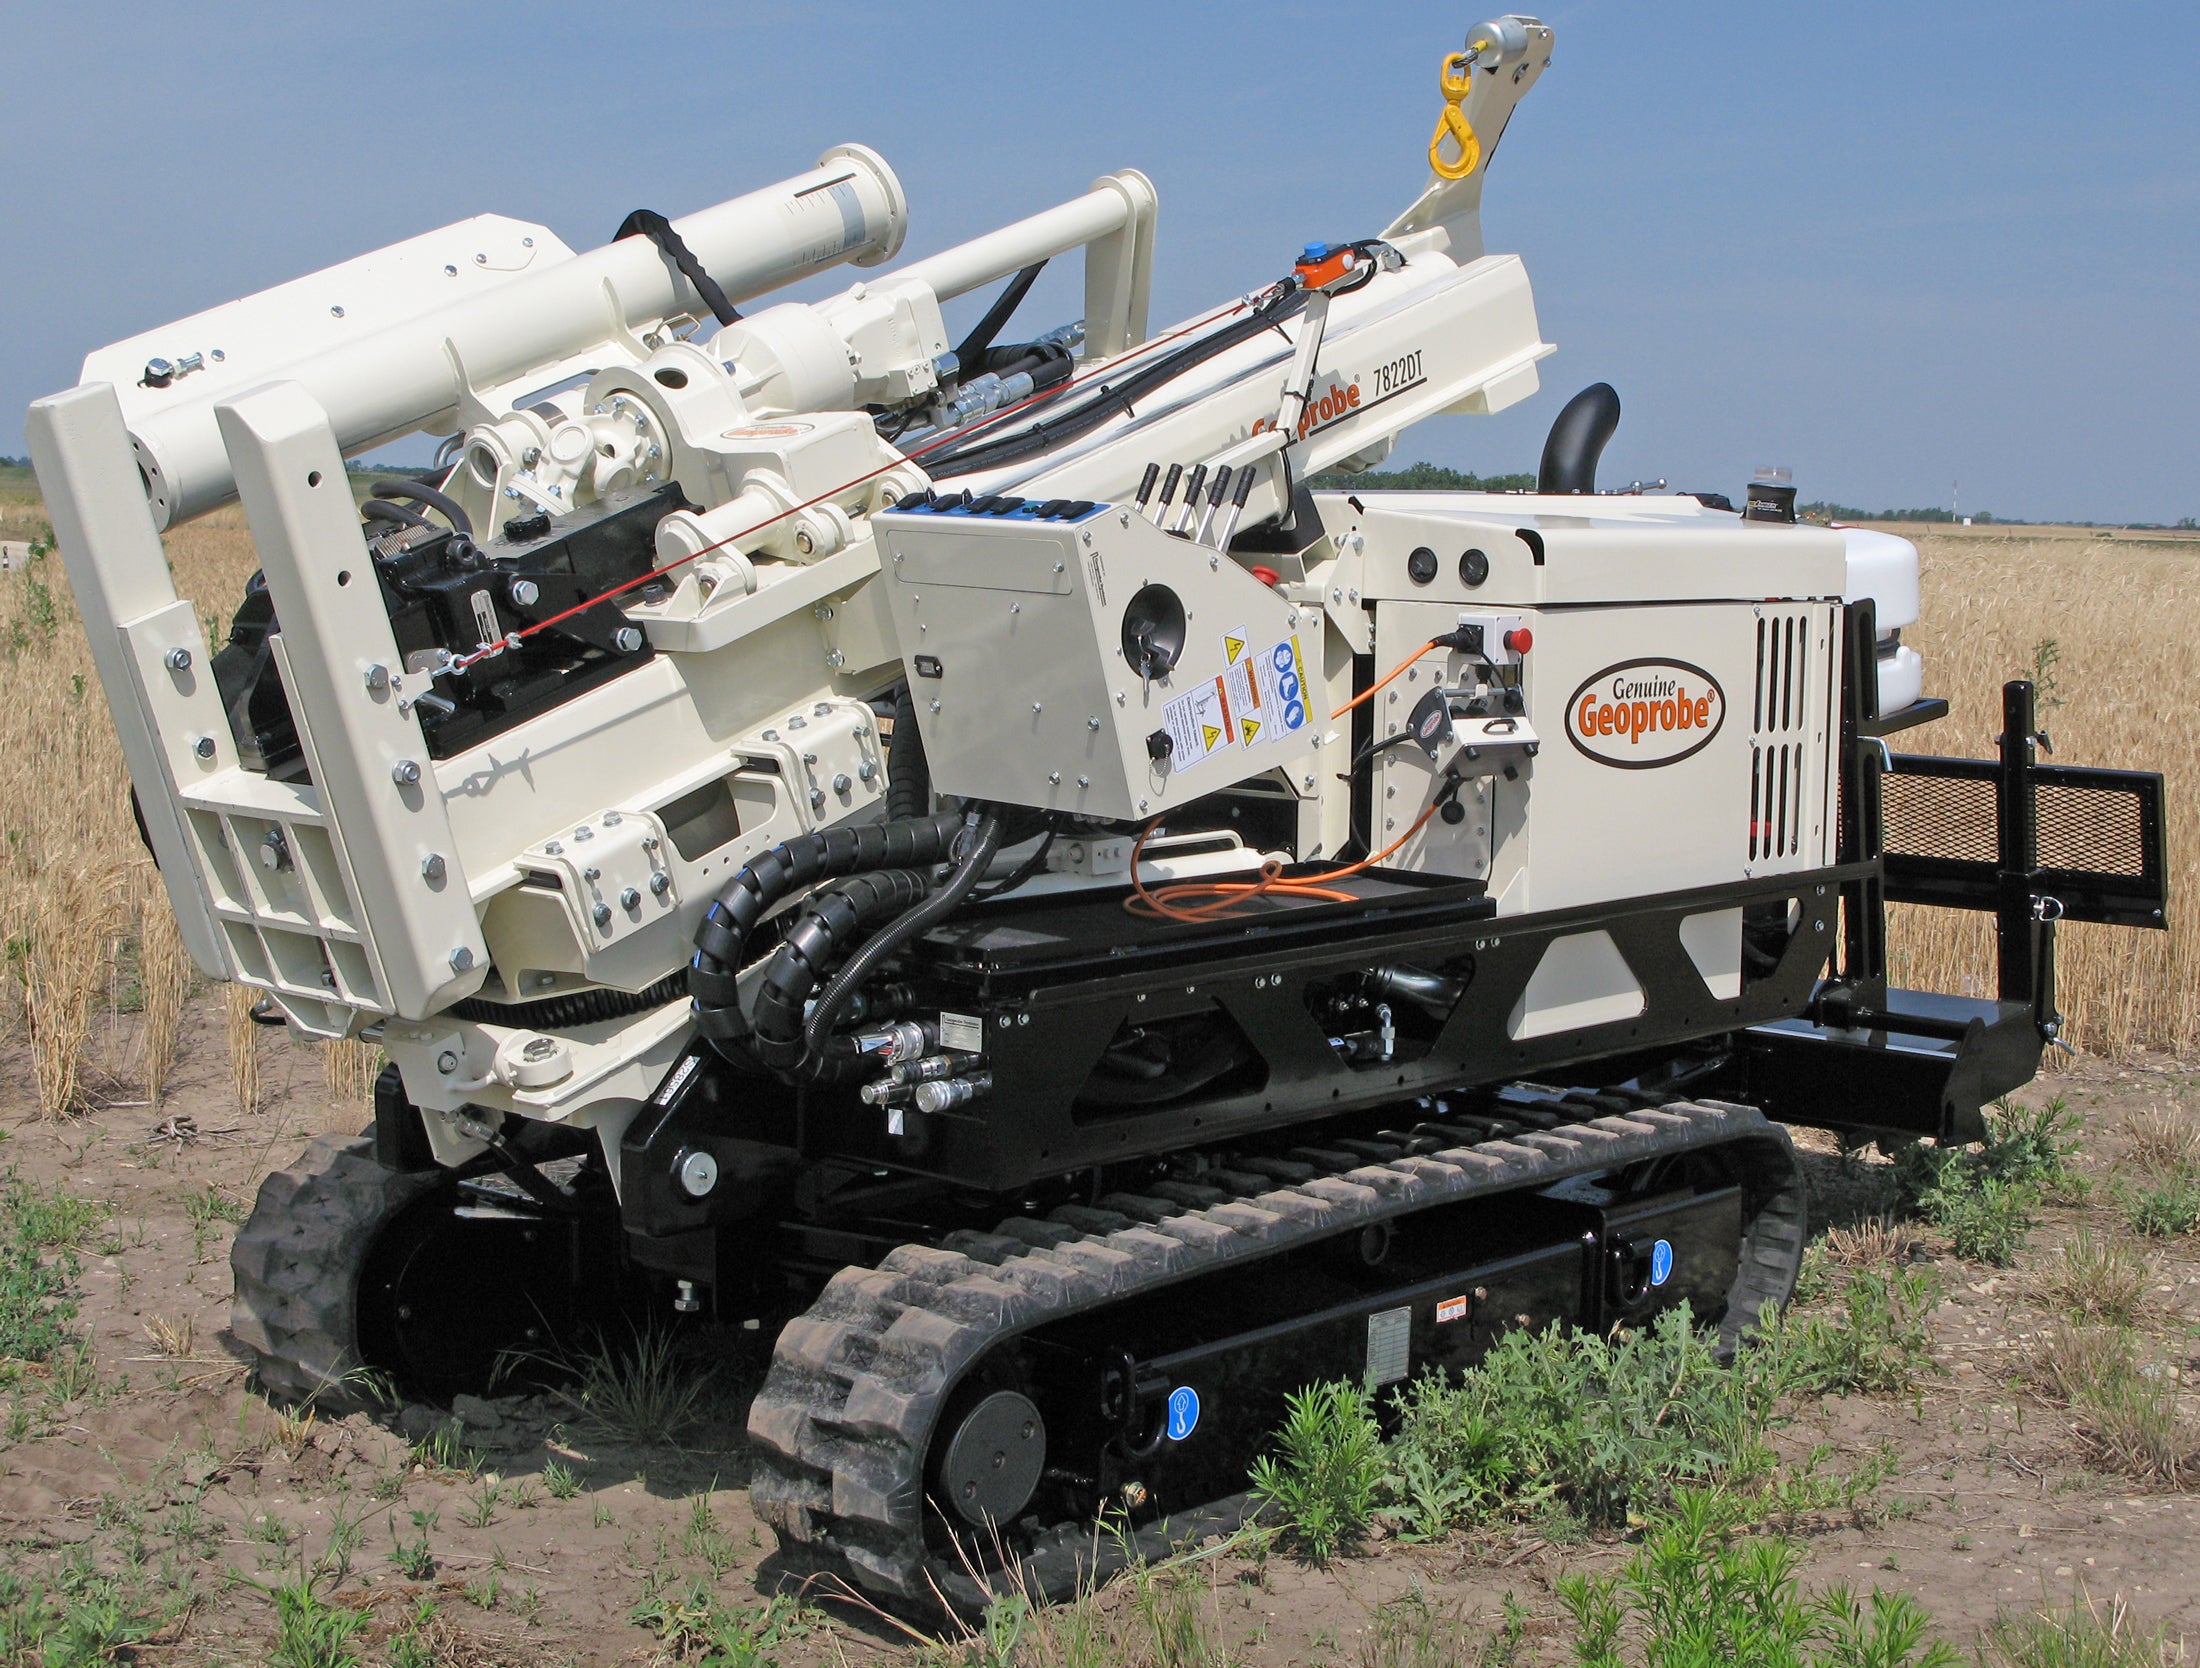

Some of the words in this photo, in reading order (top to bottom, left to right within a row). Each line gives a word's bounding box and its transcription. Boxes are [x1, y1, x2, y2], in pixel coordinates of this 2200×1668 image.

[1373, 350, 1422, 396] 7822DT
[1298, 666, 1308, 700] CAUTION
[1613, 675, 1676, 700] Genuine
